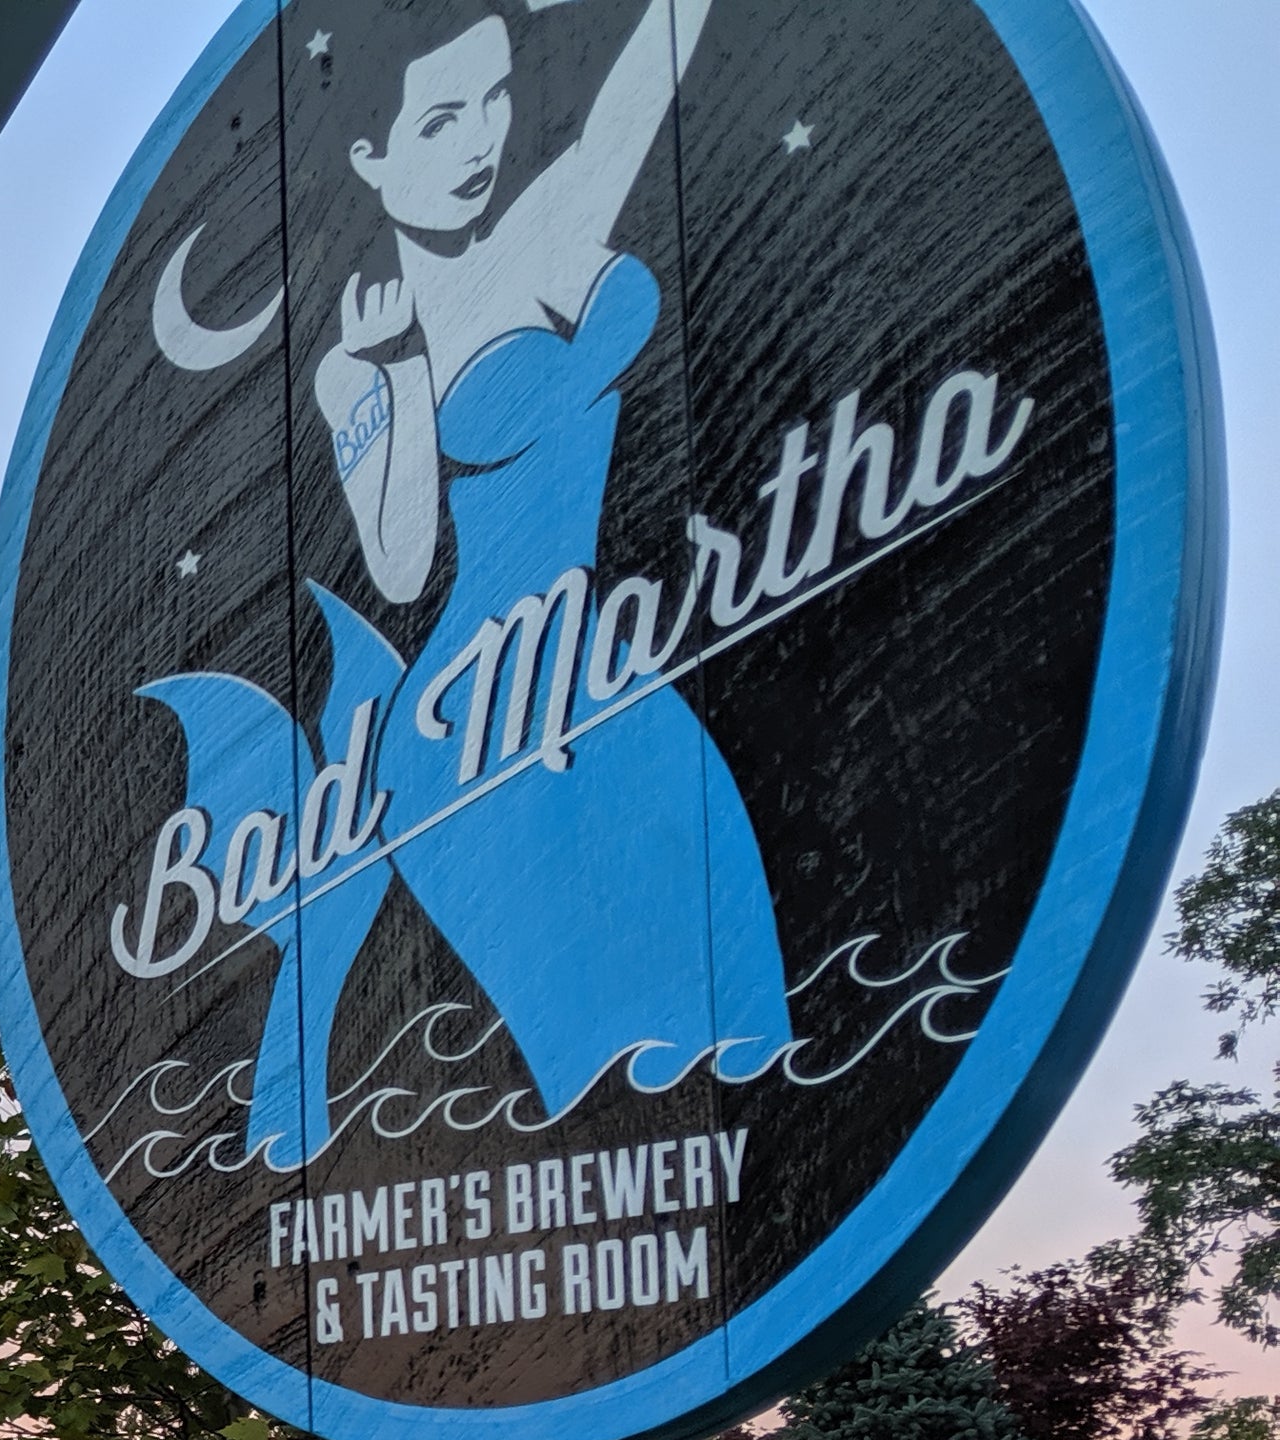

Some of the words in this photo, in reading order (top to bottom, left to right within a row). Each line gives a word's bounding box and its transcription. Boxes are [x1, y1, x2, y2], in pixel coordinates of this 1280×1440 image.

[110, 696, 392, 979] Bad
[415, 370, 1035, 786] Martha
[269, 1170, 490, 1269] FARMER'S
[507, 1128, 749, 1235] BREWERY
[316, 1277, 344, 1345] &
[356, 1249, 546, 1340] TASTING
[563, 1226, 710, 1315] ROOM
